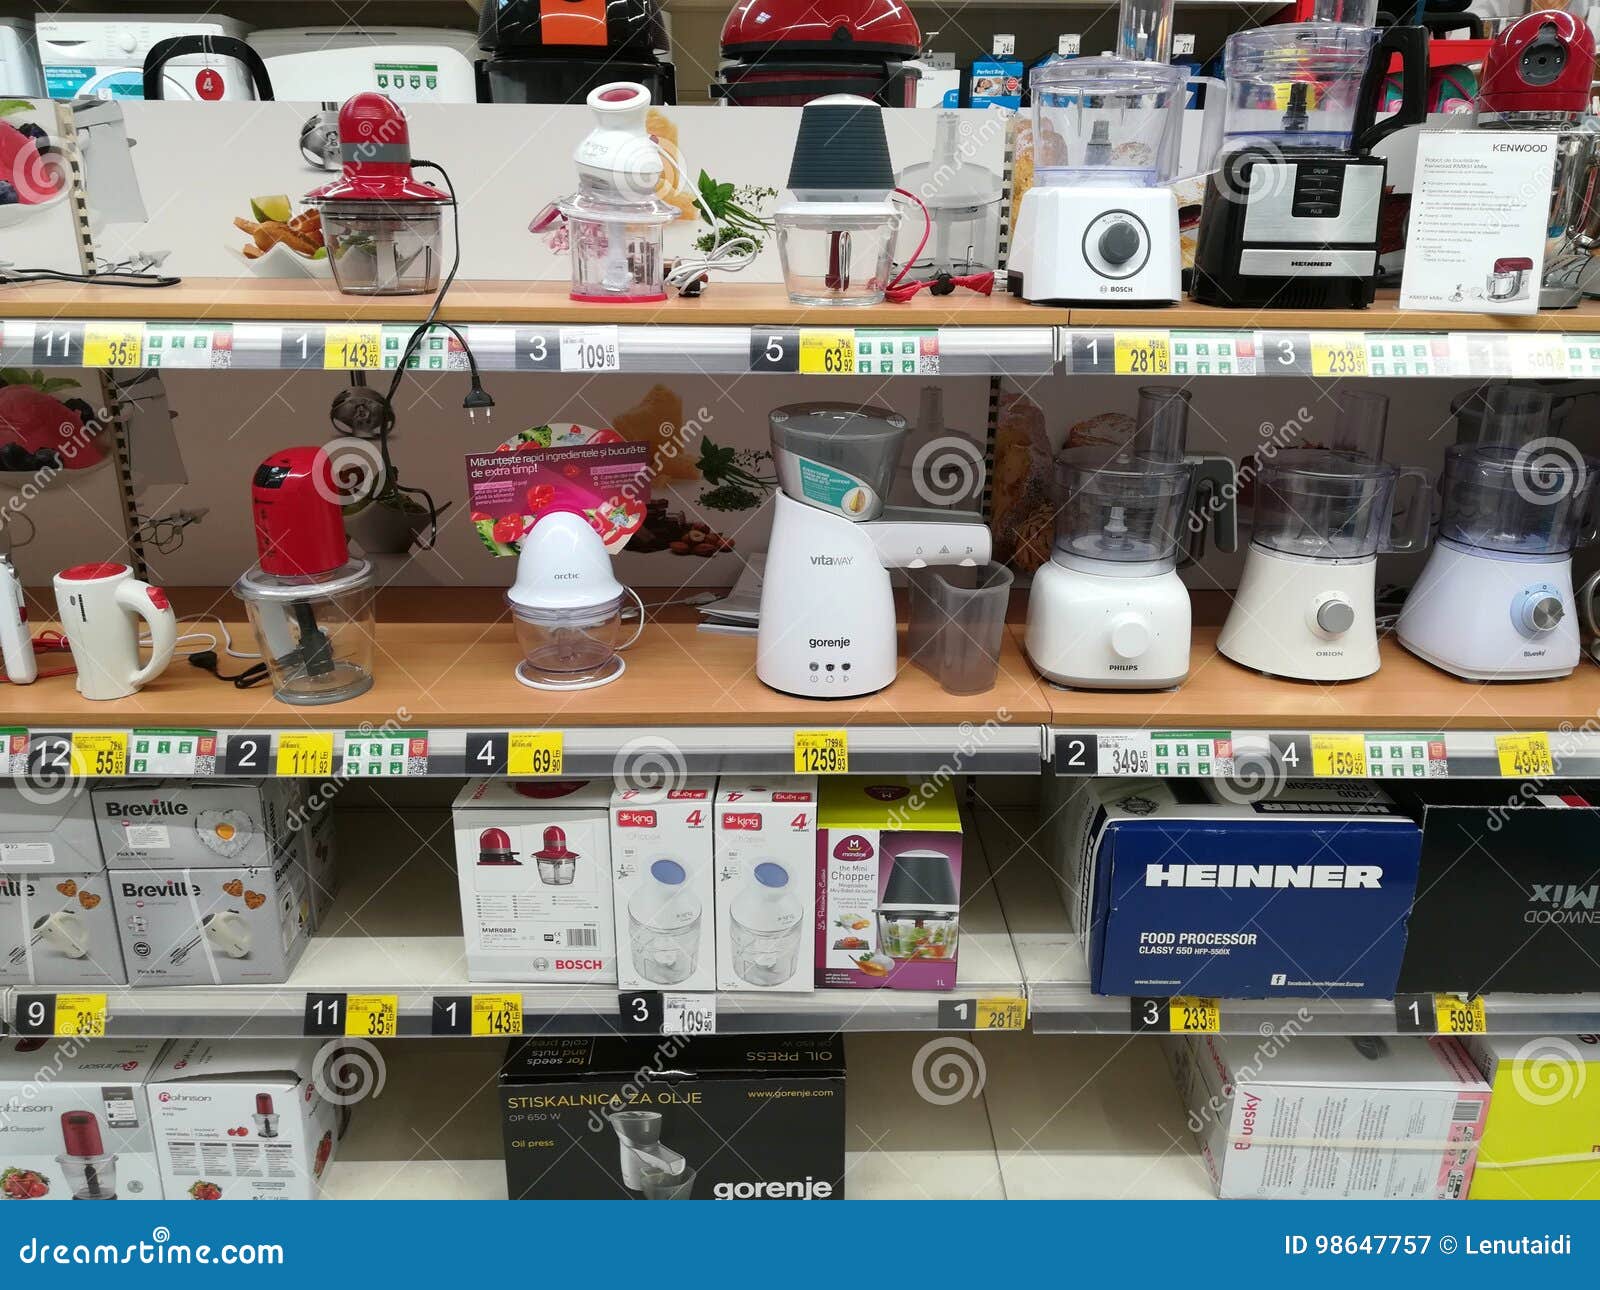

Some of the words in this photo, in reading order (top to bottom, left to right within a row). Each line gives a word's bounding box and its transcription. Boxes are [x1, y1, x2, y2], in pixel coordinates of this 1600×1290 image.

[202, 77, 213, 92] 4
[1492, 143, 1548, 153] KENWOOD
[42, 330, 71, 357] 11
[108, 341, 127, 365] 35
[128, 353, 137, 365] 91
[296, 333, 308, 359] 1
[341, 343, 368, 367] 143
[369, 356, 378, 367] 92
[529, 336, 548, 361] 3
[765, 335, 784, 362] 5
[1086, 339, 1099, 365] 1
[1277, 339, 1296, 365] 3
[578, 344, 605, 369] 109
[606, 354, 615, 368] 90
[825, 348, 842, 372] 63
[844, 359, 853, 372] 92
[1130, 349, 1157, 373] 281
[1159, 360, 1168, 372] 94
[1328, 350, 1356, 373] 233
[523, 453, 545, 465] rapid
[545, 449, 599, 462] ingredientele
[608, 446, 646, 456] bucură-te
[471, 469, 484, 478] de
[484, 466, 510, 478] extra
[512, 463, 538, 476] timp!
[808, 637, 851, 648] gorenje
[36, 740, 71, 767] 12
[96, 751, 115, 775] 55
[115, 760, 124, 774] 93
[238, 740, 257, 767] 2
[292, 750, 317, 775] 111
[319, 760, 329, 774] 92
[477, 740, 496, 766] 4
[533, 749, 551, 773] 69
[552, 759, 561, 772] 90
[803, 747, 837, 772] 1259
[837, 758, 846, 770] 93
[1068, 740, 1086, 766] 2
[1112, 749, 1139, 774] 349
[1140, 760, 1149, 773] 90
[1281, 742, 1300, 768] 4
[1328, 751, 1354, 775] 159
[1355, 762, 1364, 775] 92
[1514, 750, 1540, 775] 499
[106, 799, 189, 817] Breville
[632, 813, 653, 825] king
[686, 809, 702, 826] 4
[1261, 803, 1391, 813] HEINNER
[737, 817, 758, 828] king
[791, 813, 807, 830] 4
[850, 839, 859, 848] M
[831, 871, 876, 882] Chopper
[853, 864, 867, 872] Mini
[1146, 864, 1384, 888] HEINNER
[122, 880, 201, 897] Breville
[1528, 884, 1600, 909] Mix
[1524, 910, 1600, 923] ENWOOD
[1139, 945, 1174, 955] CLASSY
[1176, 946, 1193, 955] 550
[1140, 932, 1176, 945] FOOD
[1179, 932, 1257, 945] PROCESSOR
[555, 959, 603, 970] BOSCH
[28, 1001, 45, 1026] 9
[313, 1000, 338, 1025] 11
[446, 1001, 457, 1026] 1
[631, 997, 649, 1022] 3
[680, 1009, 704, 1033] 109
[704, 1019, 713, 1031] 90
[953, 1002, 968, 1020] 1
[989, 1011, 1013, 1028] 281
[1143, 1000, 1160, 1025] 3
[1183, 1007, 1208, 1031] 233
[1408, 1000, 1420, 1025] 1
[1450, 1009, 1475, 1032] 599
[368, 1012, 385, 1035] 35
[385, 1022, 394, 1035] 91
[487, 1010, 512, 1034] 143
[512, 1021, 521, 1033] 92
[532, 1049, 559, 1057] nuts
[563, 1049, 587, 1057] and
[561, 1039, 589, 1048] cold
[527, 1057, 563, 1065] seeds
[567, 1057, 586, 1065] for
[746, 1051, 800, 1061] PRESS
[806, 1051, 833, 1061] OIL
[158, 1091, 212, 1102] Rohnson
[508, 1093, 622, 1109] STISKALNICA
[628, 1093, 652, 1104] ZA
[658, 1092, 702, 1104] OLJE
[748, 1088, 834, 1098] www.gorenje.com
[509, 1114, 525, 1122] OP
[527, 1113, 547, 1121] 650
[1234, 1091, 1262, 1151] Buesky
[512, 1140, 525, 1148] Oil
[528, 1140, 554, 1149] press
[713, 1176, 832, 1200] gorenje
